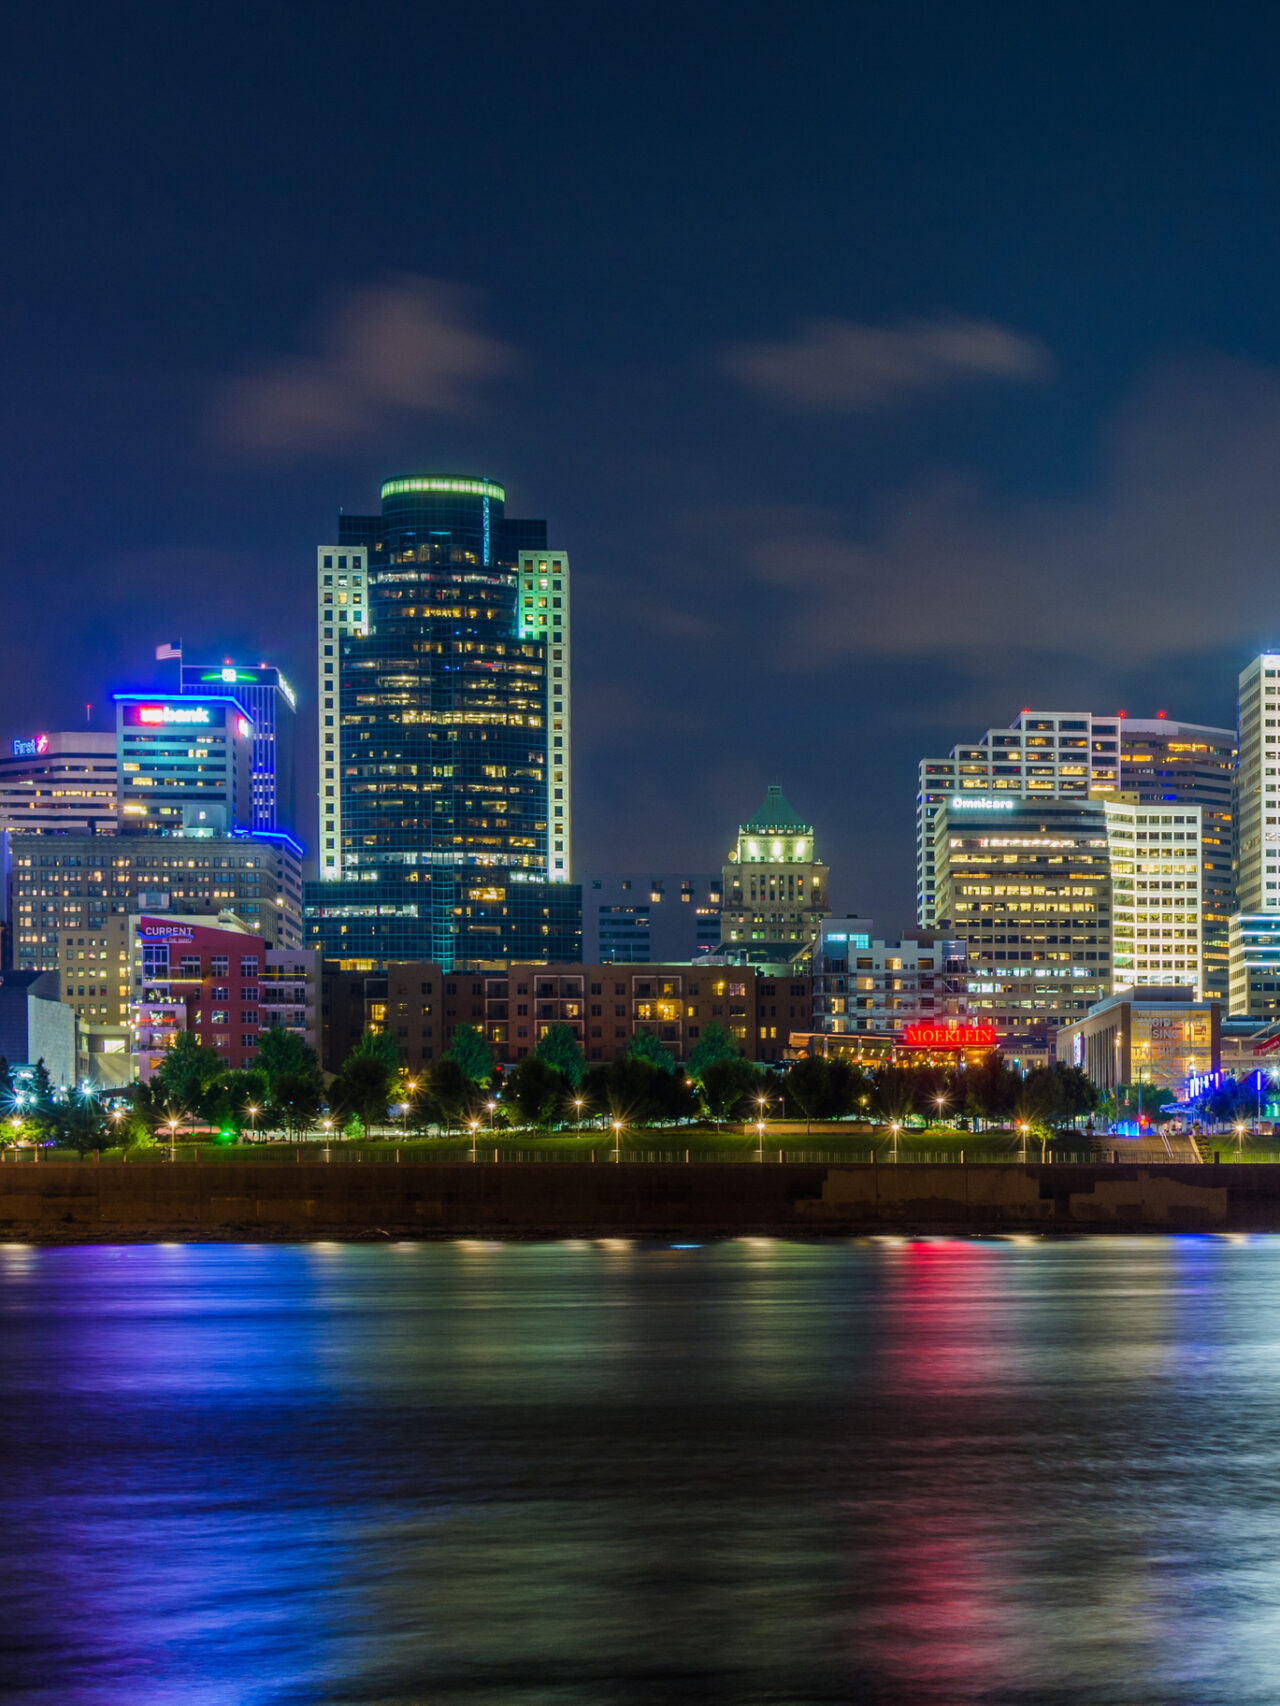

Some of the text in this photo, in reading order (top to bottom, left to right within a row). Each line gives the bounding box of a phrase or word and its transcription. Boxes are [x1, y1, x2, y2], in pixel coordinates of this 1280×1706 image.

[14, 739, 36, 755] First
[953, 798, 1014, 809] Omnicare
[145, 926, 193, 936] CURRENT
[908, 1029, 993, 1042] MOERLEIN
[1152, 1029, 1179, 1039] SING
